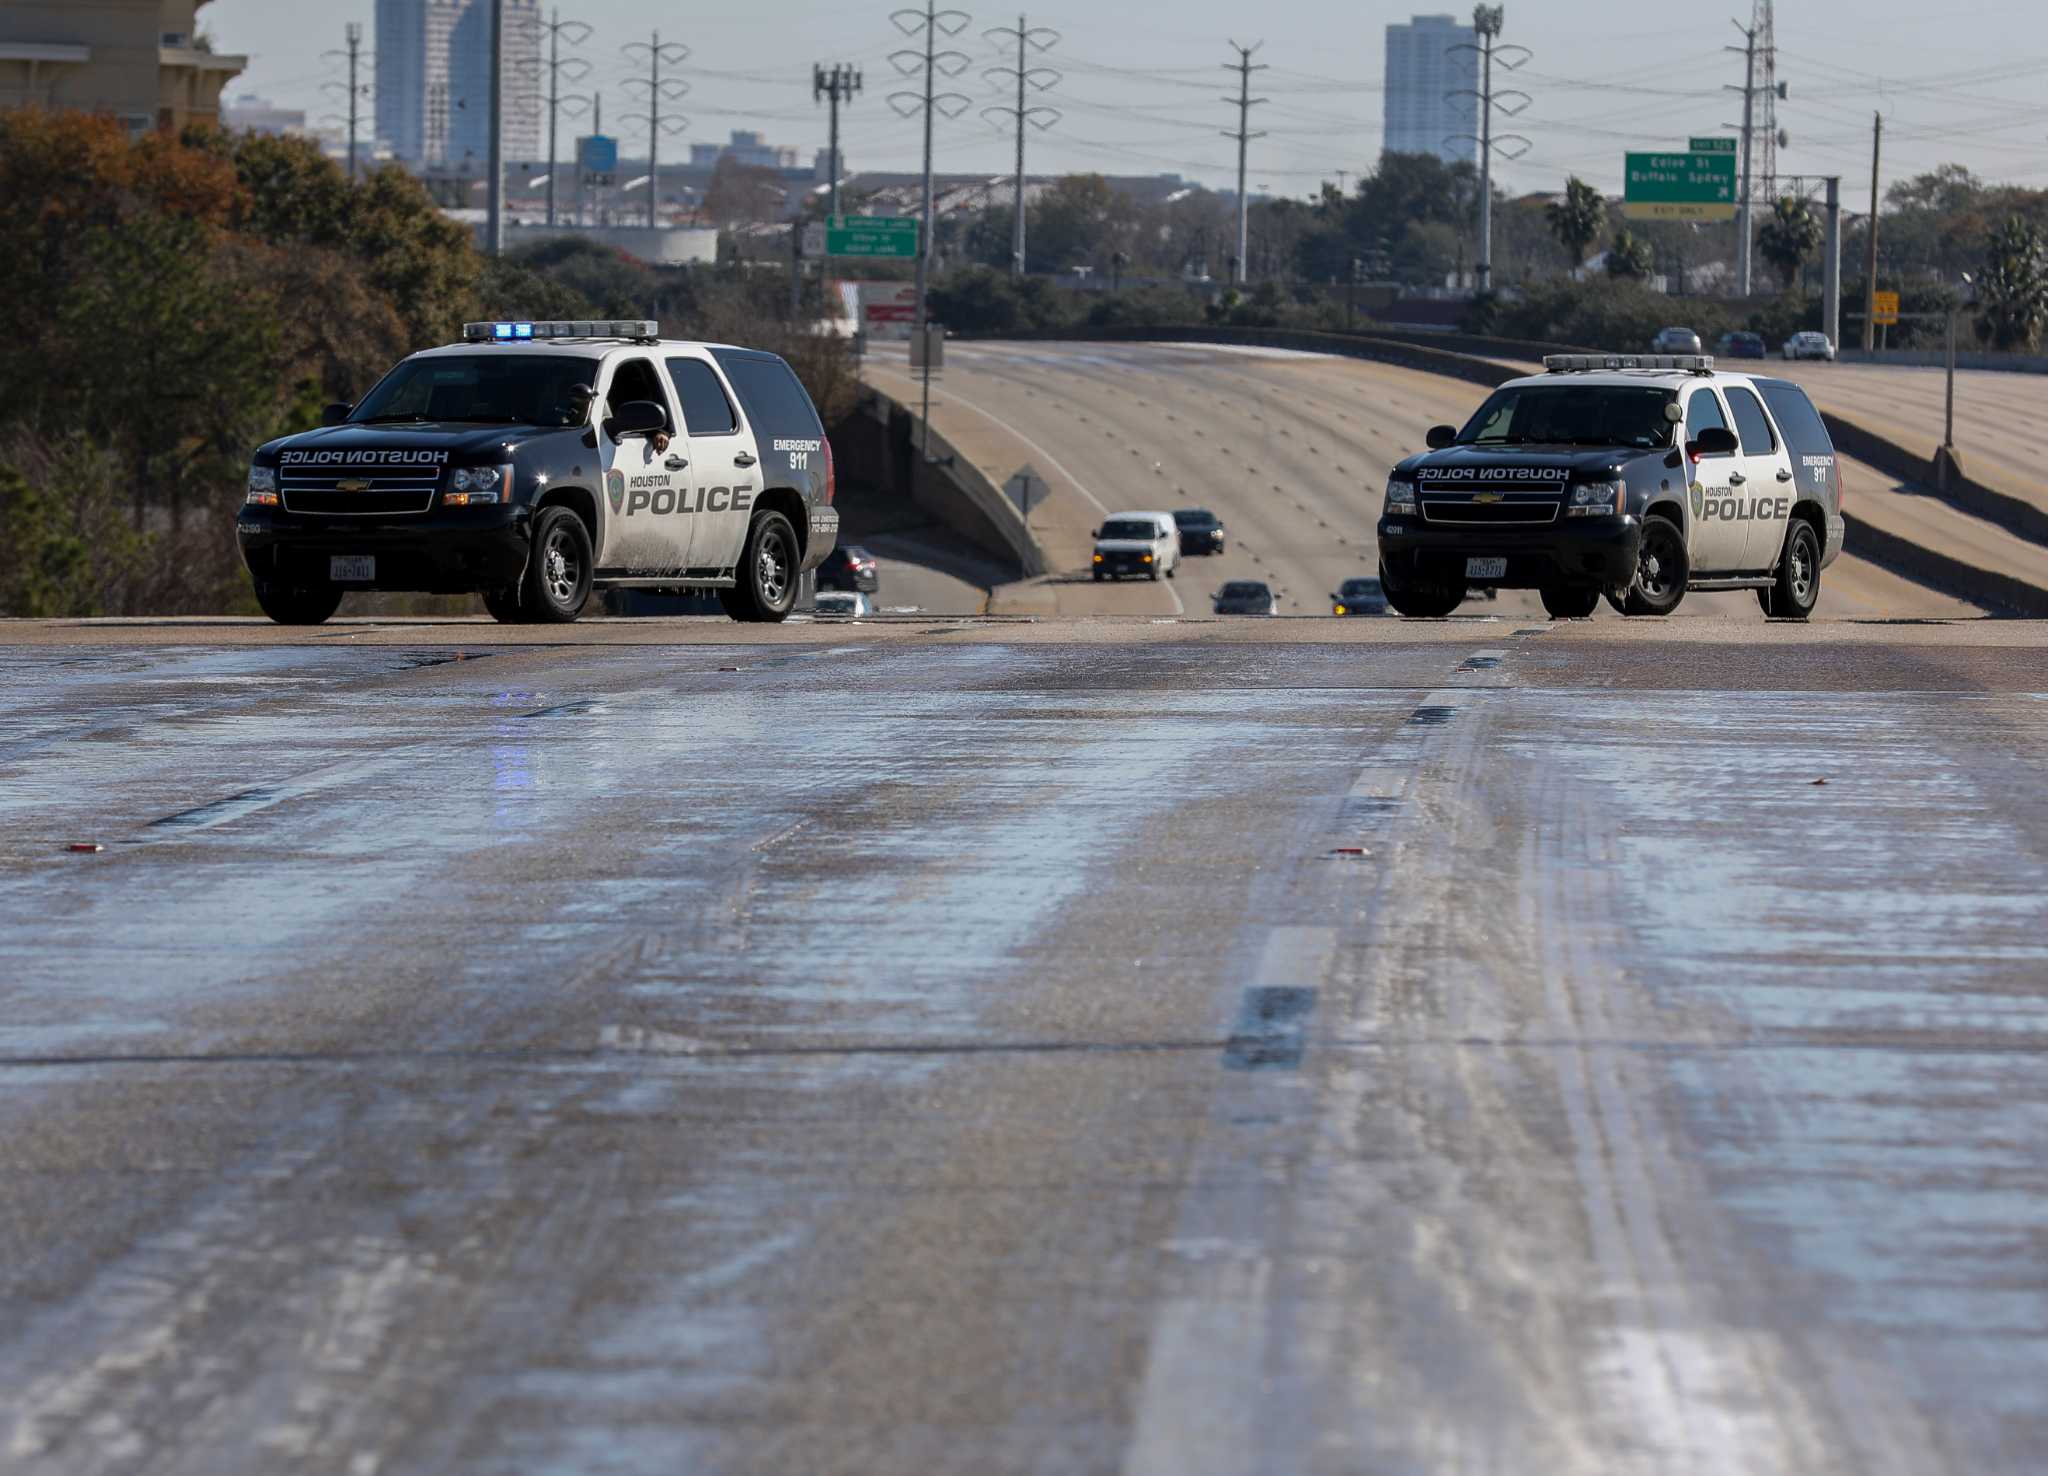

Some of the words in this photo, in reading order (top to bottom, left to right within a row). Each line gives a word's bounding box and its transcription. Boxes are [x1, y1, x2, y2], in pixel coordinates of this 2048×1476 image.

[773, 440, 821, 451] EMERGENCY
[790, 452, 807, 470] 911
[1802, 455, 1834, 467] EMERGENCY
[630, 474, 671, 489] HOUSTON
[1814, 466, 1826, 483] 911
[1705, 486, 1733, 497] HOUSTON
[626, 485, 753, 517] POLICE
[1703, 497, 1789, 521] POLICE
